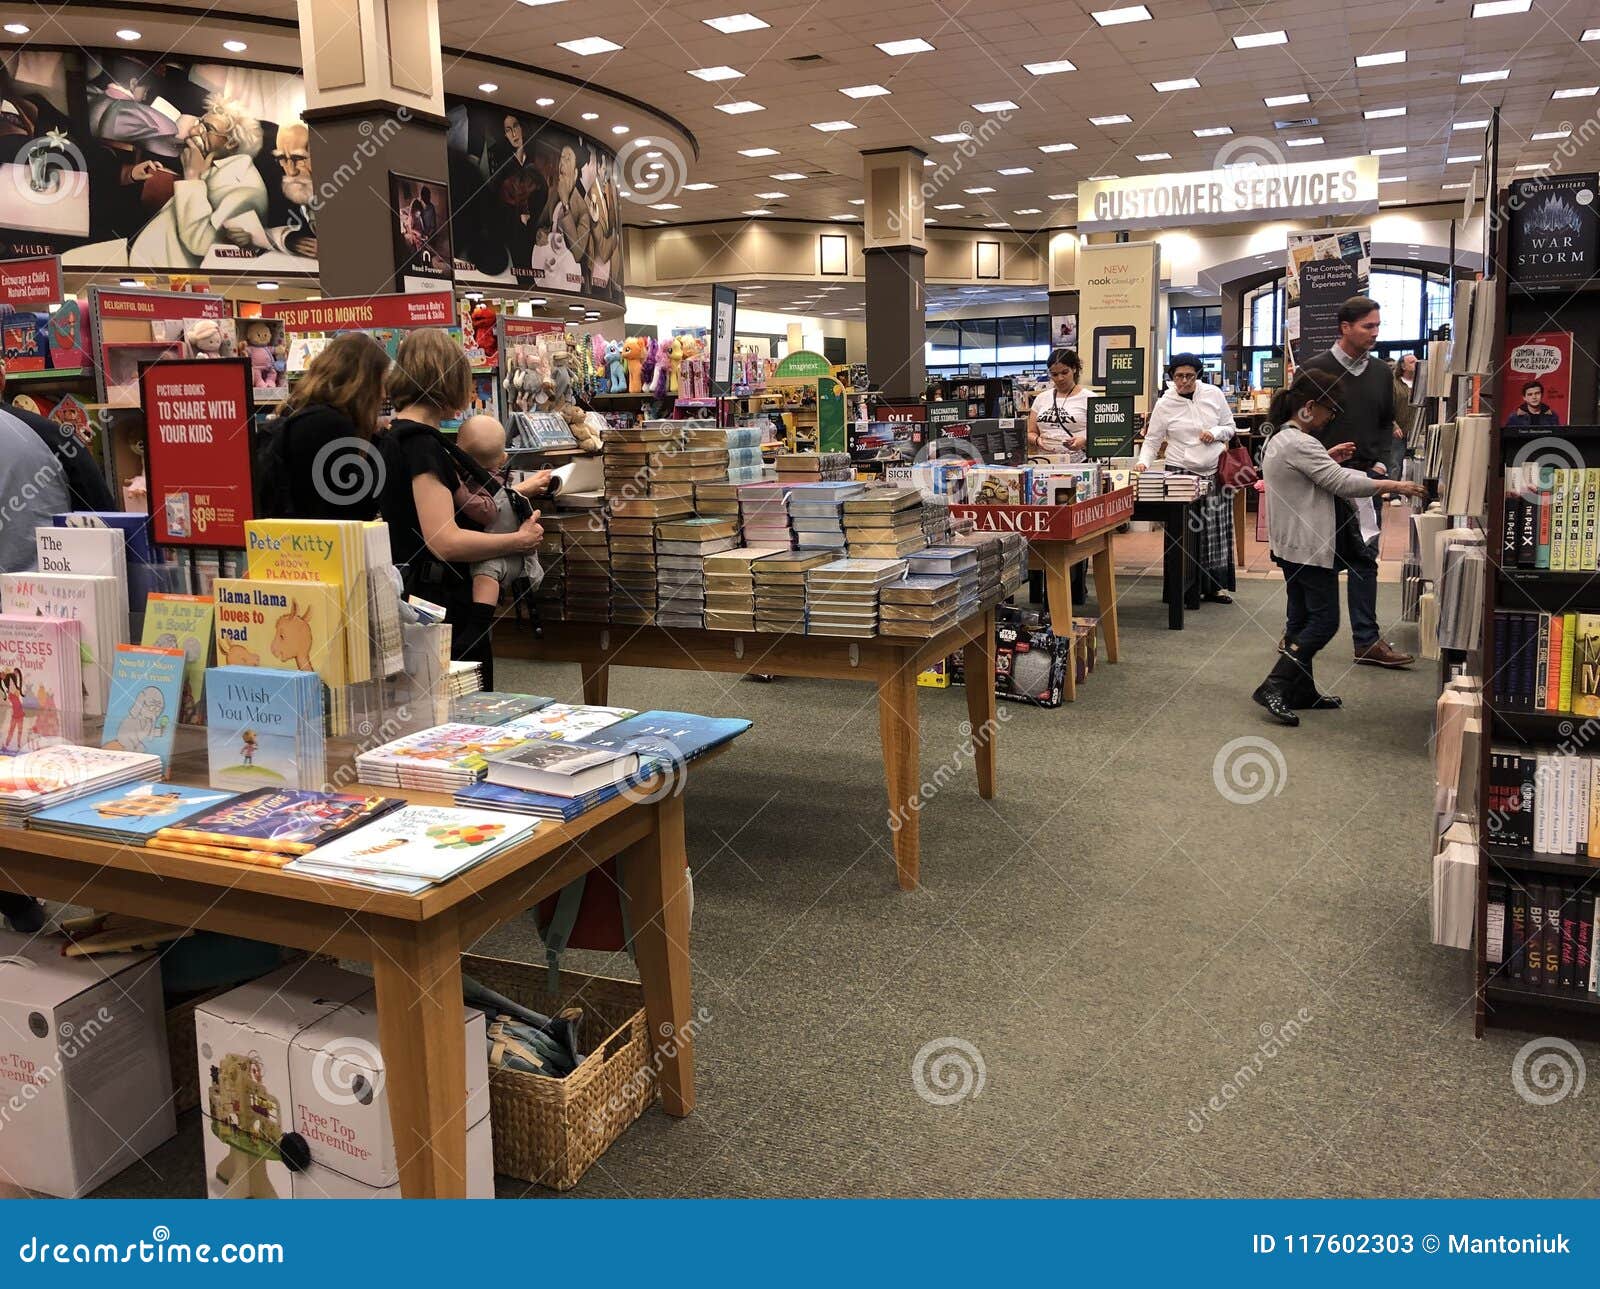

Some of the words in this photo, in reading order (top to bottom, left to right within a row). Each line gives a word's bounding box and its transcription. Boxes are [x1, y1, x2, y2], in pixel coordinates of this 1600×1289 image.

[1095, 186, 1223, 221] CUSTOMER
[1235, 170, 1357, 211] SERVICES
[1532, 237, 1573, 249] WAR
[218, 249, 253, 258] TWAIN
[1518, 251, 1584, 265] STORM
[1104, 265, 1129, 274] NEW
[1320, 264, 1352, 272] Complete
[1, 274, 27, 286] Encourage
[32, 271, 50, 283] Child's
[1088, 276, 1111, 286] nook
[1306, 273, 1326, 281] Digital
[1327, 272, 1353, 280] Reading
[8, 286, 27, 297] Natural
[28, 285, 50, 297] Curiosity
[1311, 281, 1346, 289] Experience
[103, 300, 137, 311] DELIGHTFUL
[137, 302, 155, 312] DOLLS
[274, 310, 295, 326] AGES
[296, 309, 309, 324] UP
[310, 308, 322, 324] TO
[324, 308, 333, 323] 18
[335, 306, 373, 322] MONTHS
[1112, 357, 1133, 370] FREE
[156, 384, 183, 396] PICTURE
[183, 383, 206, 396] BOOKS
[157, 401, 172, 420] TO
[172, 401, 207, 420] SHARE
[208, 400, 236, 419] WITH
[930, 407, 958, 416] FASCINATING
[1094, 403, 1119, 414] SIGNED
[888, 414, 913, 422] SALE
[1094, 413, 1125, 424] EDITIONS
[159, 425, 188, 444] YOUR
[188, 424, 213, 443] KIDS
[194, 494, 210, 506] ONLY
[1073, 502, 1105, 529] CLEARANCE
[1106, 495, 1133, 516] CLEARANCE
[41, 536, 62, 550] The
[249, 531, 281, 550] Pete
[291, 534, 333, 561] Kitty
[1504, 540, 1515, 551] X
[1521, 536, 1533, 547] X
[42, 556, 71, 572] Book
[274, 560, 310, 568] GROOVY
[266, 569, 321, 581] PLAYDATE
[218, 587, 251, 604] llama
[253, 590, 287, 607] llama
[220, 606, 250, 623] loves
[252, 609, 264, 624] to
[221, 626, 248, 641] read
[0, 640, 53, 656] NCESSES
[234, 684, 270, 704] Wish
[217, 702, 242, 721] You
[246, 705, 282, 725] More
[1522, 786, 1532, 813] NOBODY
[1528, 951, 1541, 969] US
[1545, 954, 1559, 972] US
[10, 1054, 35, 1074] Top
[298, 1104, 327, 1128] Tree
[330, 1117, 355, 1142] Top
[301, 1121, 368, 1160] Adventure
